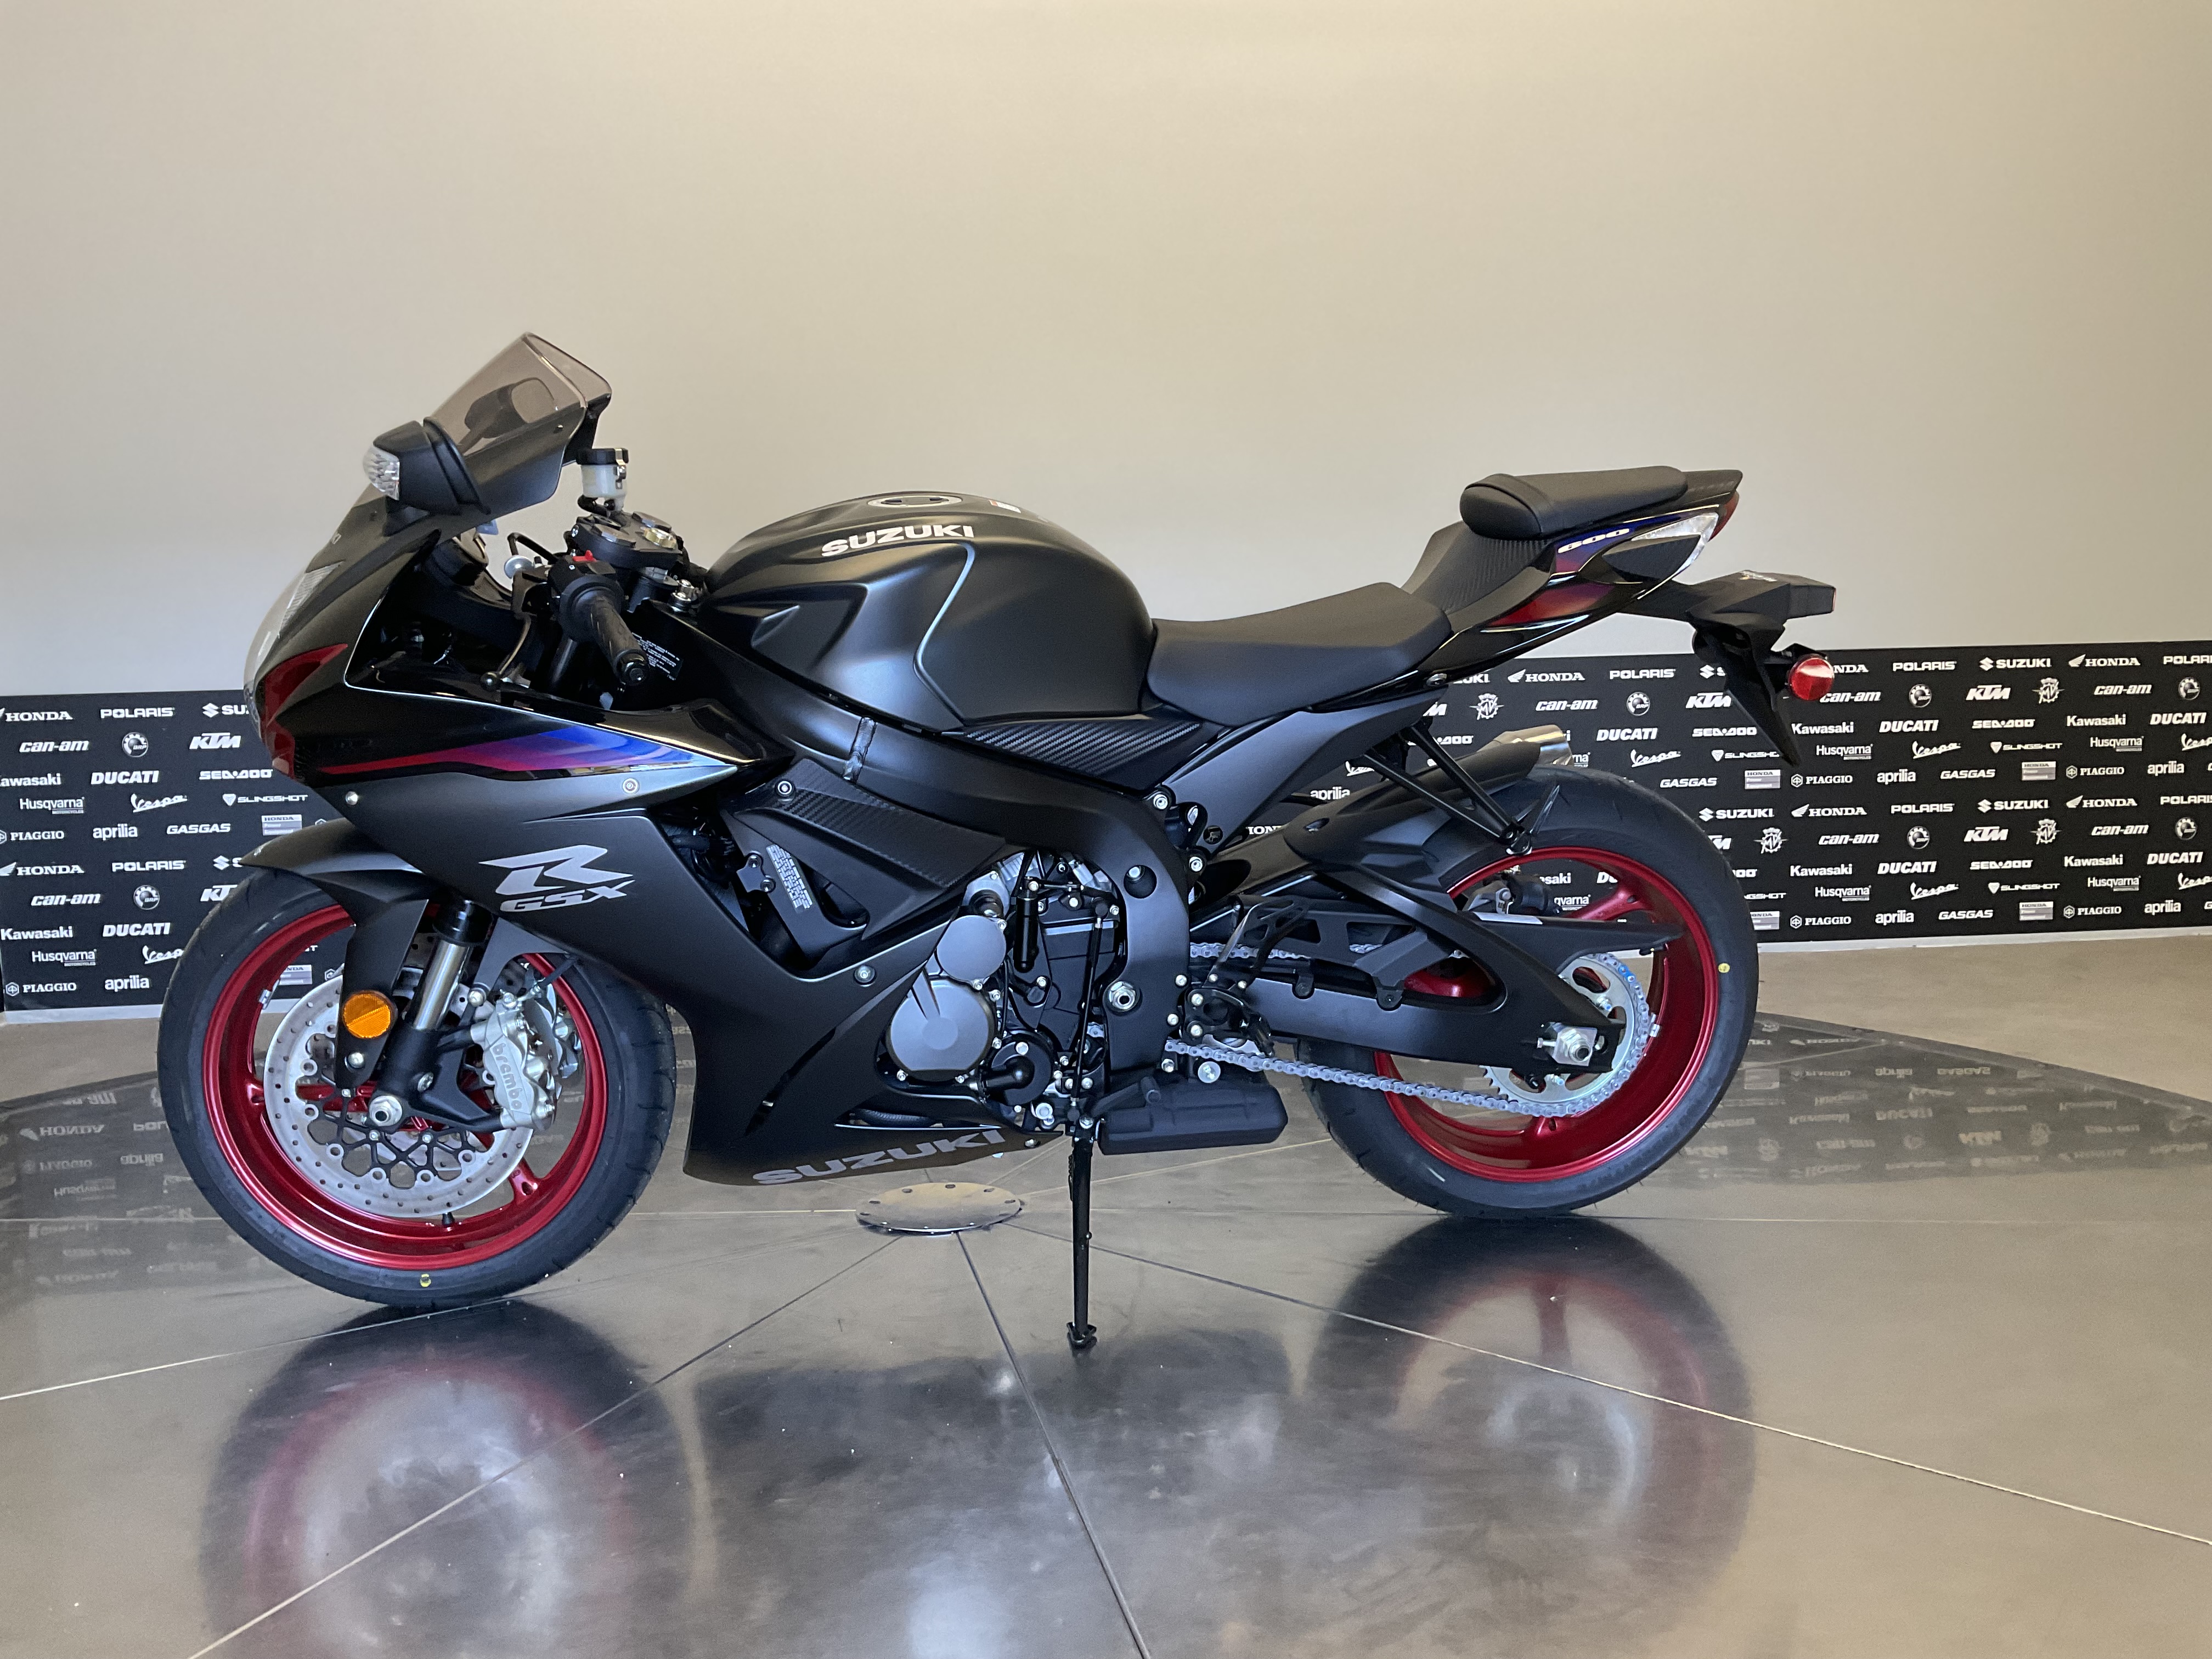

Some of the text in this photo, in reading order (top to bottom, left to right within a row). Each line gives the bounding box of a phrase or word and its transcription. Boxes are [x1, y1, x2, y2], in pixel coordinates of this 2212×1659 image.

[822, 525, 974, 556] SUZUKI
[1558, 528, 1629, 554] 600
[1834, 664, 1869, 673] NDA
[1893, 661, 1956, 671] POLARIS
[1996, 658, 2051, 668] SUZUKI
[2085, 658, 2140, 667] HONDA
[1525, 673, 1585, 682] HONDA
[1610, 669, 1675, 679] POLARIS
[1966, 685, 2011, 700] KTM
[2094, 685, 2152, 695] can-am
[1686, 692, 1731, 708] KTM
[1820, 692, 1881, 702] can-am
[1536, 700, 1598, 711] can-am
[7, 712, 73, 721] HONDA
[100, 708, 174, 718] POLARIS
[2150, 713, 2207, 725] DUCATI
[1879, 720, 1939, 732] DUCATI
[2067, 714, 2126, 726] Kawasaki
[1792, 722, 1854, 734] Kawasaki
[189, 732, 241, 749] KTM
[1596, 728, 1657, 741] DUCATI
[19, 741, 89, 752] can-am
[2090, 737, 2142, 749] Husqvarna
[1816, 744, 1873, 757] Husqvarna
[1912, 741, 1961, 759] Vespa
[1630, 749, 1681, 767] Vespa
[1940, 769, 1995, 779] GASGAS
[2080, 767, 2124, 775] PIAGGIO
[2148, 761, 2184, 776] aprilia
[0, 773, 61, 787] awasaki
[91, 770, 159, 785] DUCATI
[1660, 777, 1717, 787] GASGAS
[1806, 775, 1853, 784] PIAGGIO
[1877, 769, 1916, 785] aprilia
[1311, 787, 1350, 800] aprilia
[20, 797, 84, 811] Husqvarna
[131, 794, 187, 812] Vespa
[1891, 804, 1955, 814] POLARIS
[1994, 800, 2049, 810] SUZUKI
[2083, 798, 2137, 808] HONDA
[1716, 809, 1774, 819] SUZUKI
[1809, 807, 1867, 816] HONDA
[93, 823, 138, 840] aprilia
[167, 823, 230, 834] GASGAS
[1964, 826, 2008, 842] KTM
[2091, 825, 2148, 836] can-am
[10, 831, 64, 840] PIAGGIO
[1819, 834, 1879, 845] can-am
[2064, 854, 2123, 867] Kawasaki
[2147, 852, 2203, 864] DUCATI
[17, 865, 84, 876] HONDA
[112, 860, 186, 872] POLARIS
[1791, 864, 1852, 876] Kawasaki
[1877, 861, 1937, 874] DUCATI
[2088, 876, 2140, 889] Husqvarna
[500, 880, 635, 912] GSX
[1815, 885, 1871, 899] Husqvarna
[1910, 883, 1959, 900] Vespa
[31, 894, 100, 906] can-am
[2078, 906, 2121, 915] PIAGGIO
[2145, 900, 2181, 915] aprilia
[1875, 910, 1914, 925] aprilia
[1939, 910, 1993, 919] GASGAS
[1805, 917, 1851, 925] PIAGGIO
[1, 926, 73, 940] Kawasaki
[103, 923, 170, 936] DUCATI
[32, 950, 97, 963] Husqvarna
[22, 983, 76, 992] PIAGGIO
[105, 975, 149, 992] aprilia
[493, 1042, 522, 1109] brembo
[753, 1130, 1006, 1185] SUZUKI
